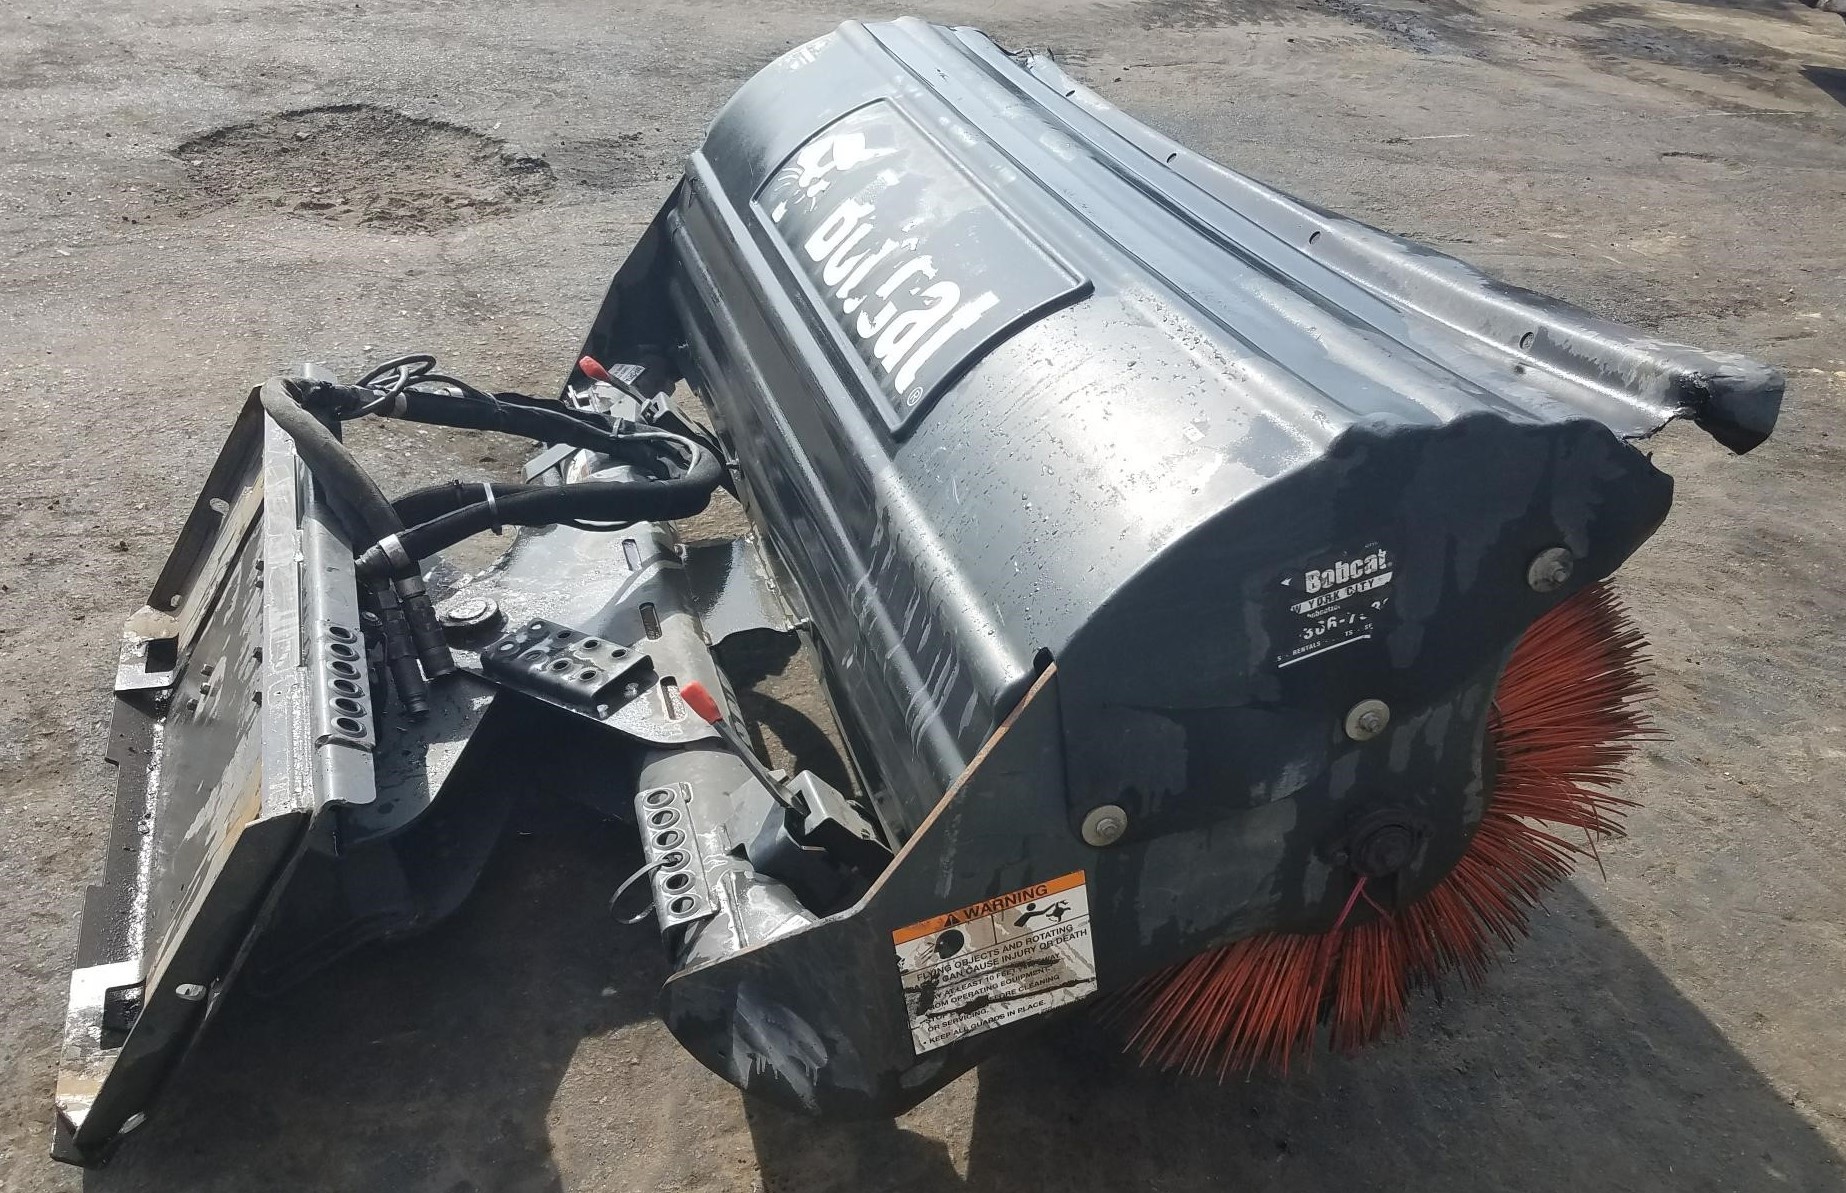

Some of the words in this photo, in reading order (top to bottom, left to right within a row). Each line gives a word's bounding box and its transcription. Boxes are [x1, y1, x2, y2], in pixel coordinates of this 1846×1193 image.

[1304, 548, 1388, 594] Bobcat
[1308, 590, 1341, 609] YORK
[1346, 579, 1376, 597] CITY
[1292, 640, 1321, 656] RENTALS
[964, 884, 1049, 922] WARNING
[917, 964, 952, 982] FLYING
[954, 948, 1000, 969] OBJECTS
[1002, 940, 1023, 953] AND
[1025, 923, 1074, 946] ROTATING
[942, 970, 964, 982] CAN
[965, 958, 1000, 975] CAUSE
[1001, 945, 1037, 963] INJURY
[1039, 941, 1054, 951] OR
[1056, 928, 1088, 945] DEATH
[950, 983, 999, 1003] OPERATING
[956, 979, 982, 993] LEAST
[985, 974, 995, 983] 10
[996, 967, 1015, 979] FEET
[1018, 974, 1060, 992] CLEANING
[927, 1024, 941, 1032] OR
[942, 1008, 990, 1028] SERVICING.
[929, 1031, 951, 1044] KEEP
[953, 1023, 968, 1035] ALL
[970, 1013, 1005, 1029] GUARDS
[1007, 1009, 1016, 1017] IN
[1017, 999, 1046, 1013] PLACE.
